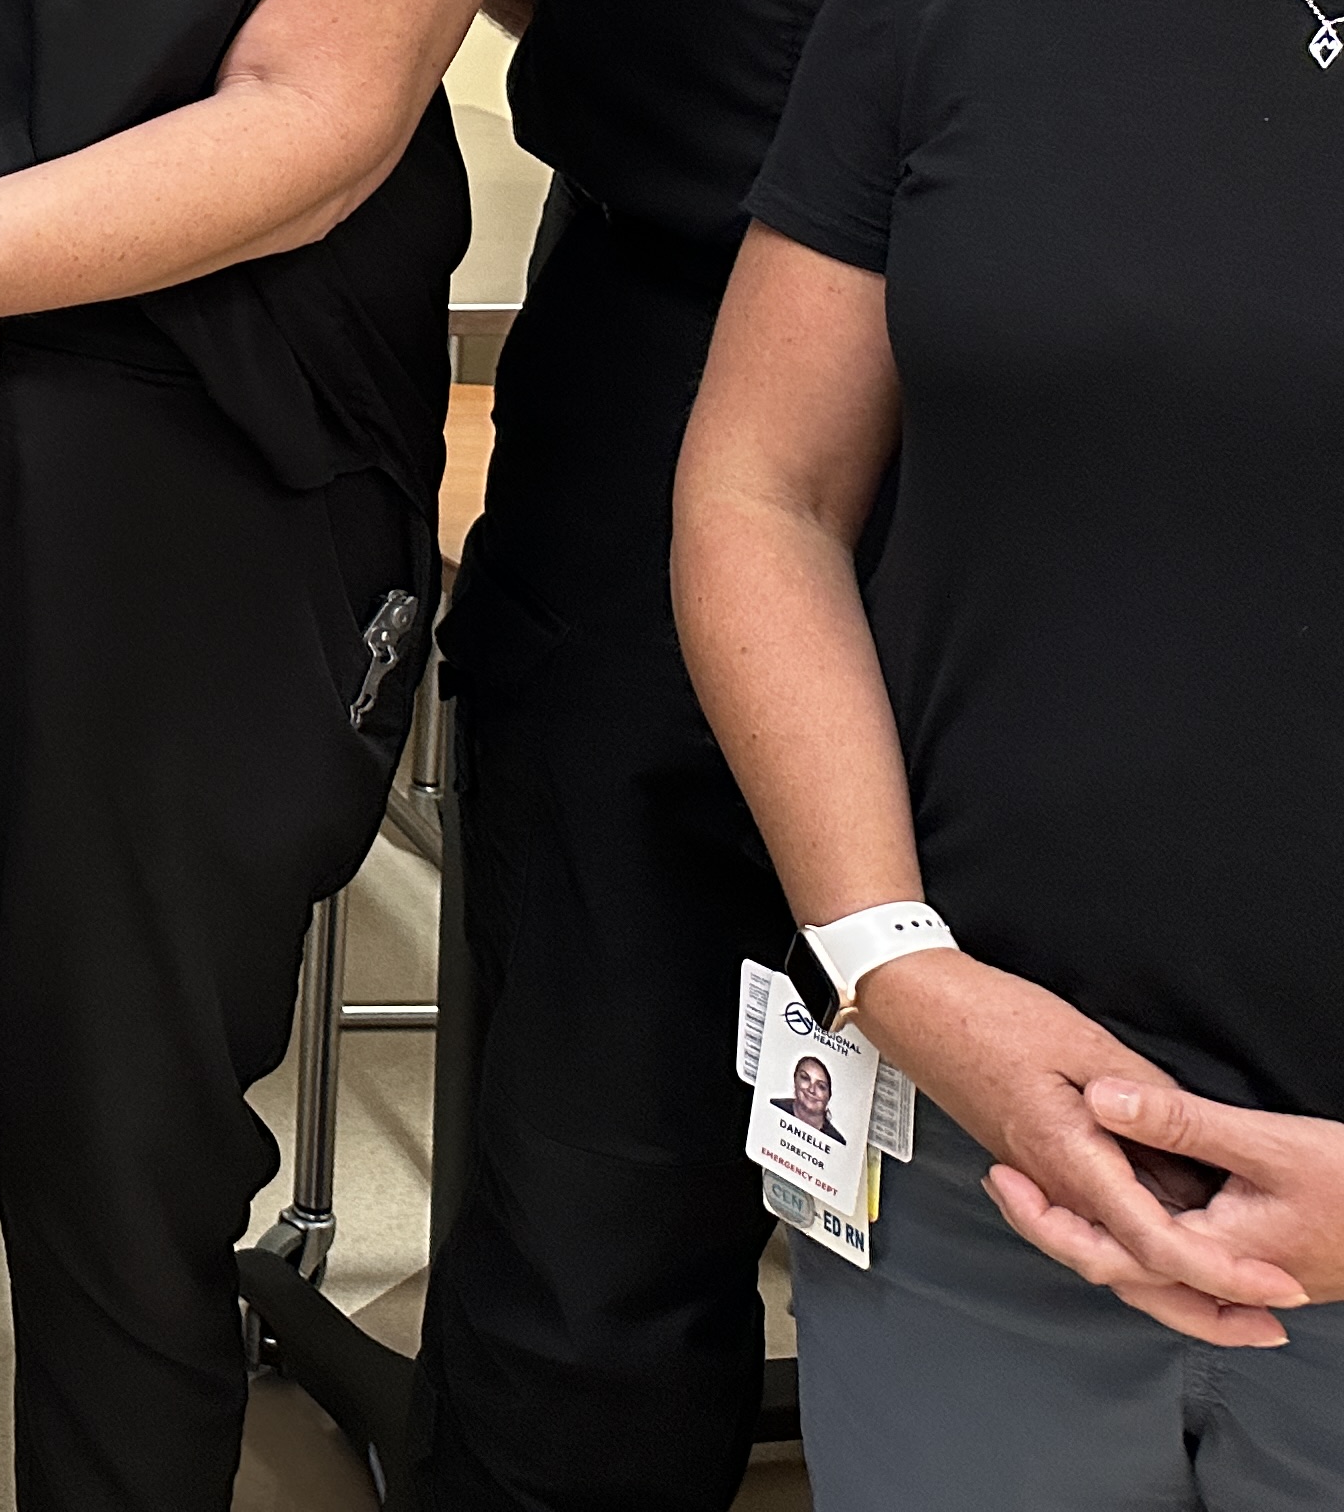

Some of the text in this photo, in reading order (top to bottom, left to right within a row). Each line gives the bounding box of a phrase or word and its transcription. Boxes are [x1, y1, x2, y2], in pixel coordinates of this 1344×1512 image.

[813, 1032, 849, 1056] HEALTH
[779, 1118, 832, 1155] DANIELLE
[779, 1138, 825, 1170] DIRECTOR
[761, 1147, 839, 1197] EMERGENCY DEPT
[823, 1209, 865, 1253] ED RN
